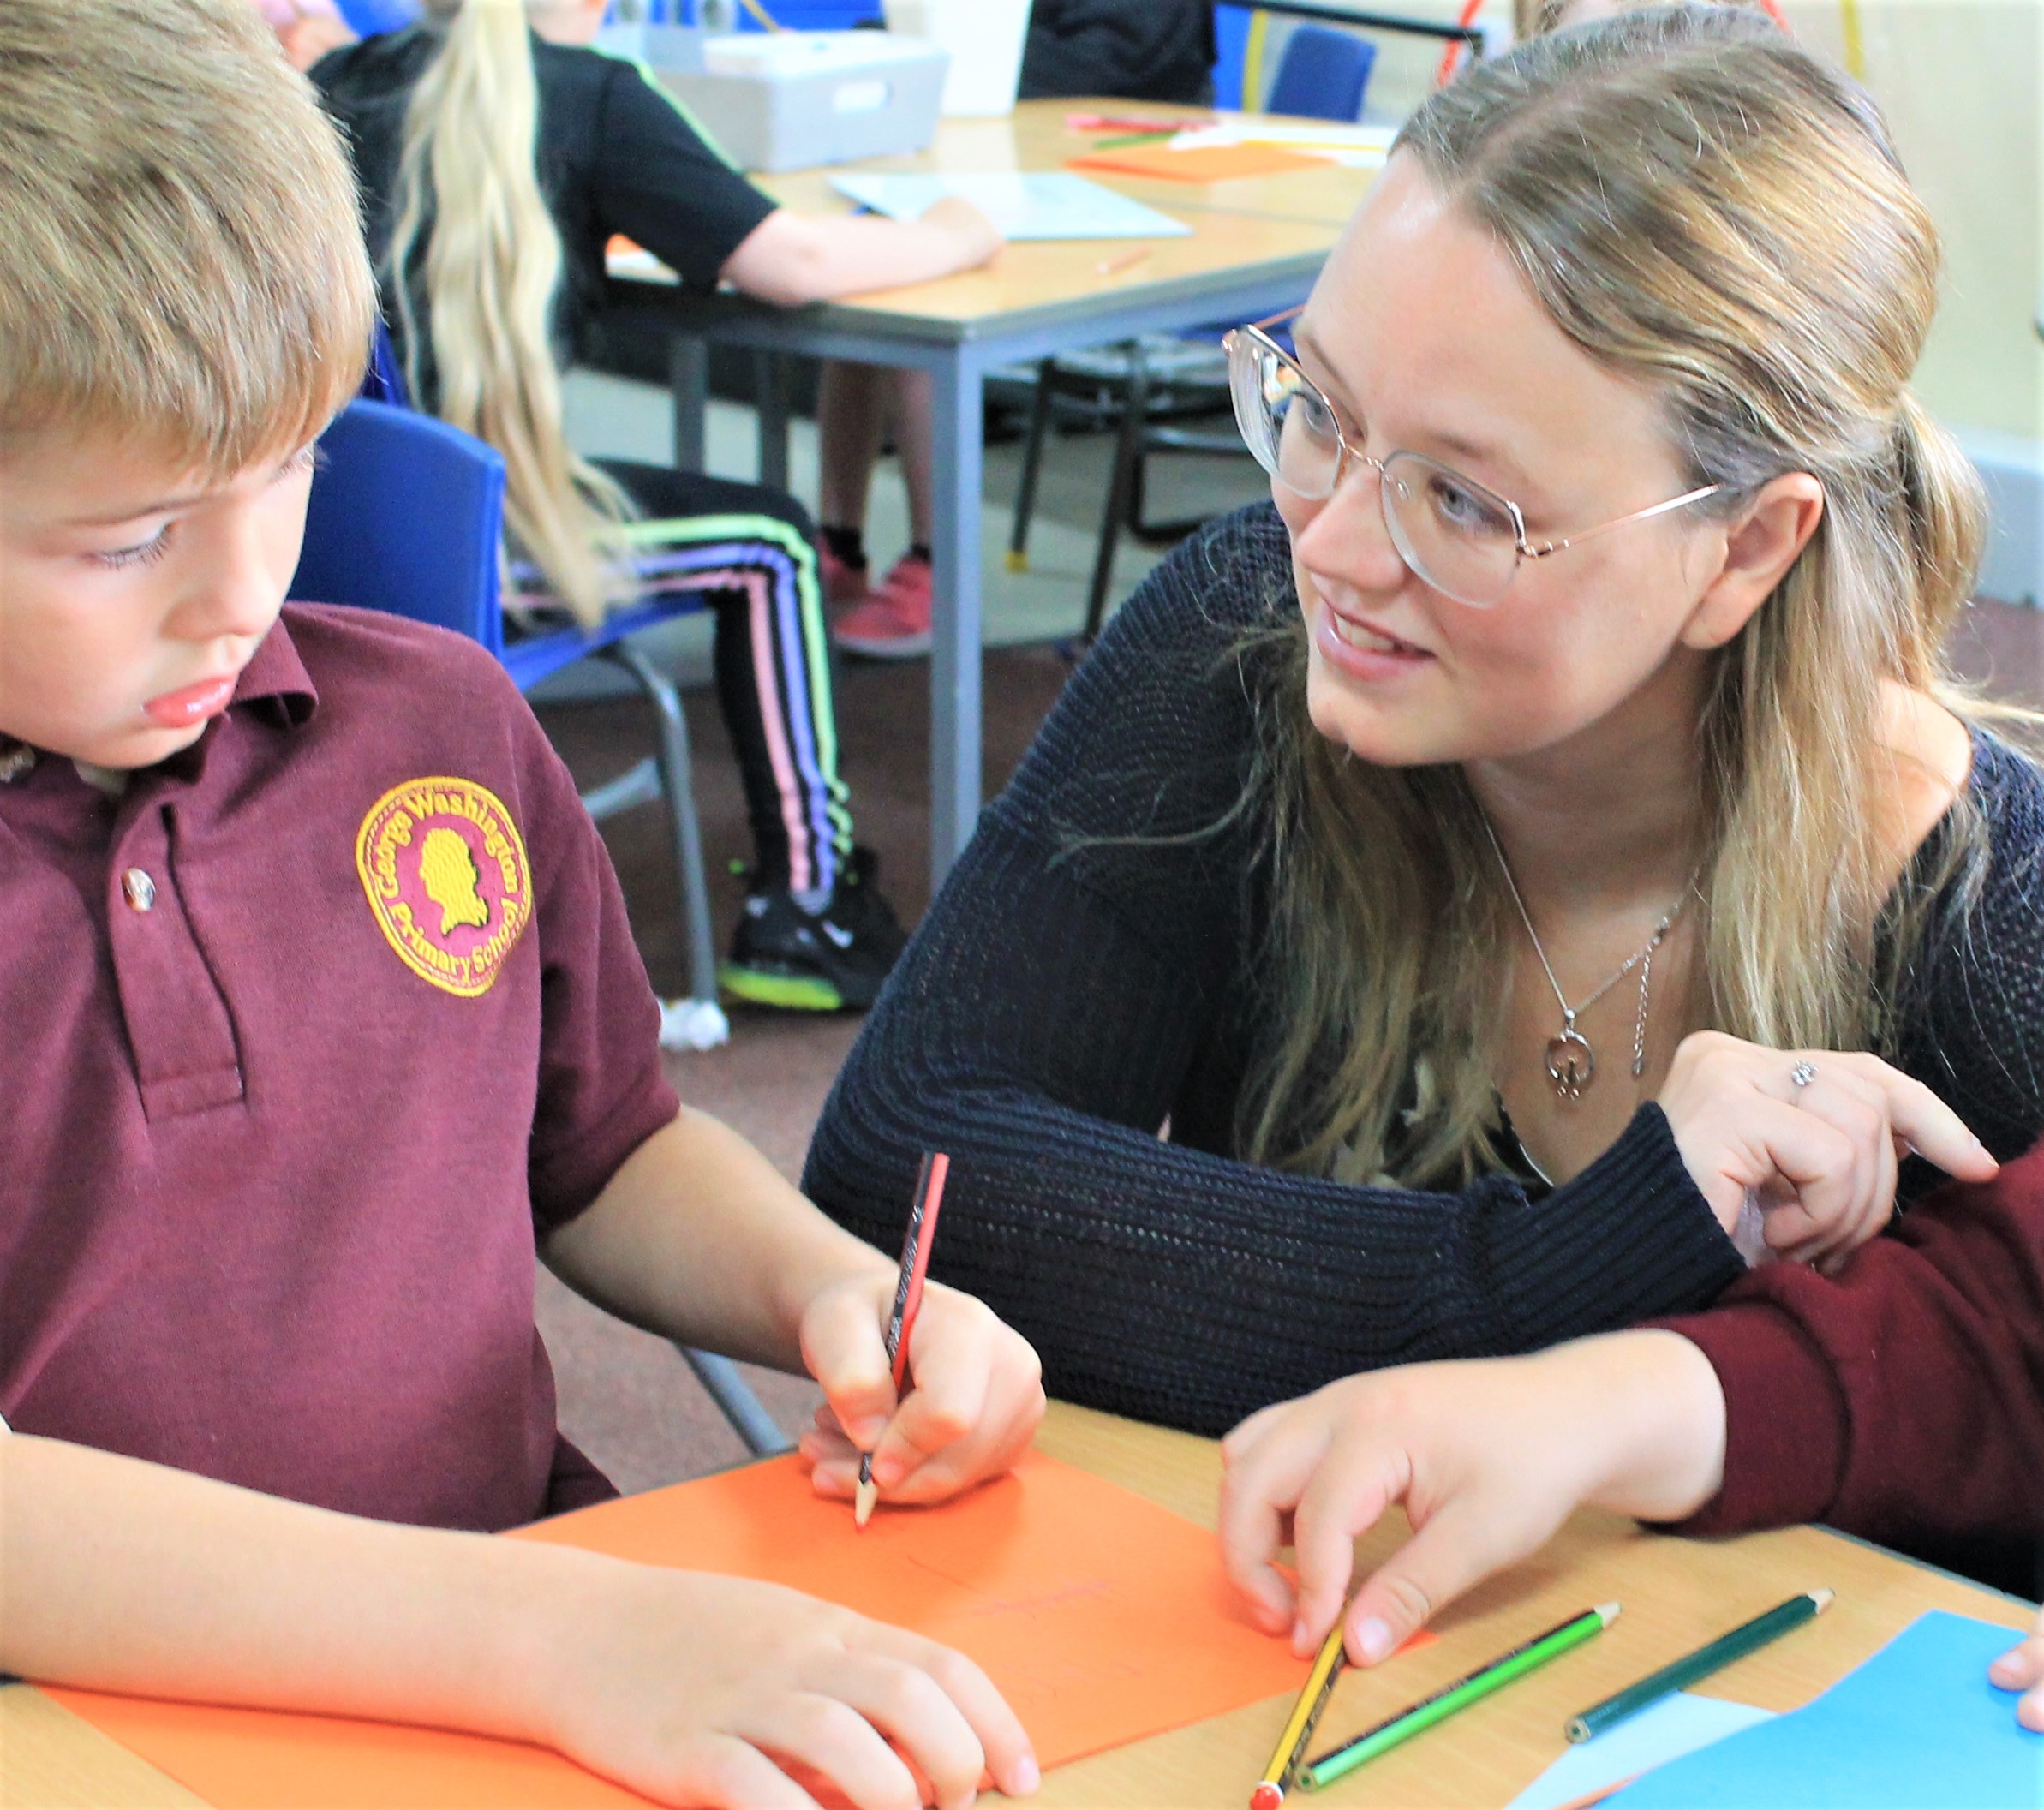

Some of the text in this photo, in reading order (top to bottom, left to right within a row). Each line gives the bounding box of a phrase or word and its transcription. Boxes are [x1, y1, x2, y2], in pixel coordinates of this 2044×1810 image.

[374, 788, 518, 899] George Washington
[390, 897, 518, 982] Primary School
